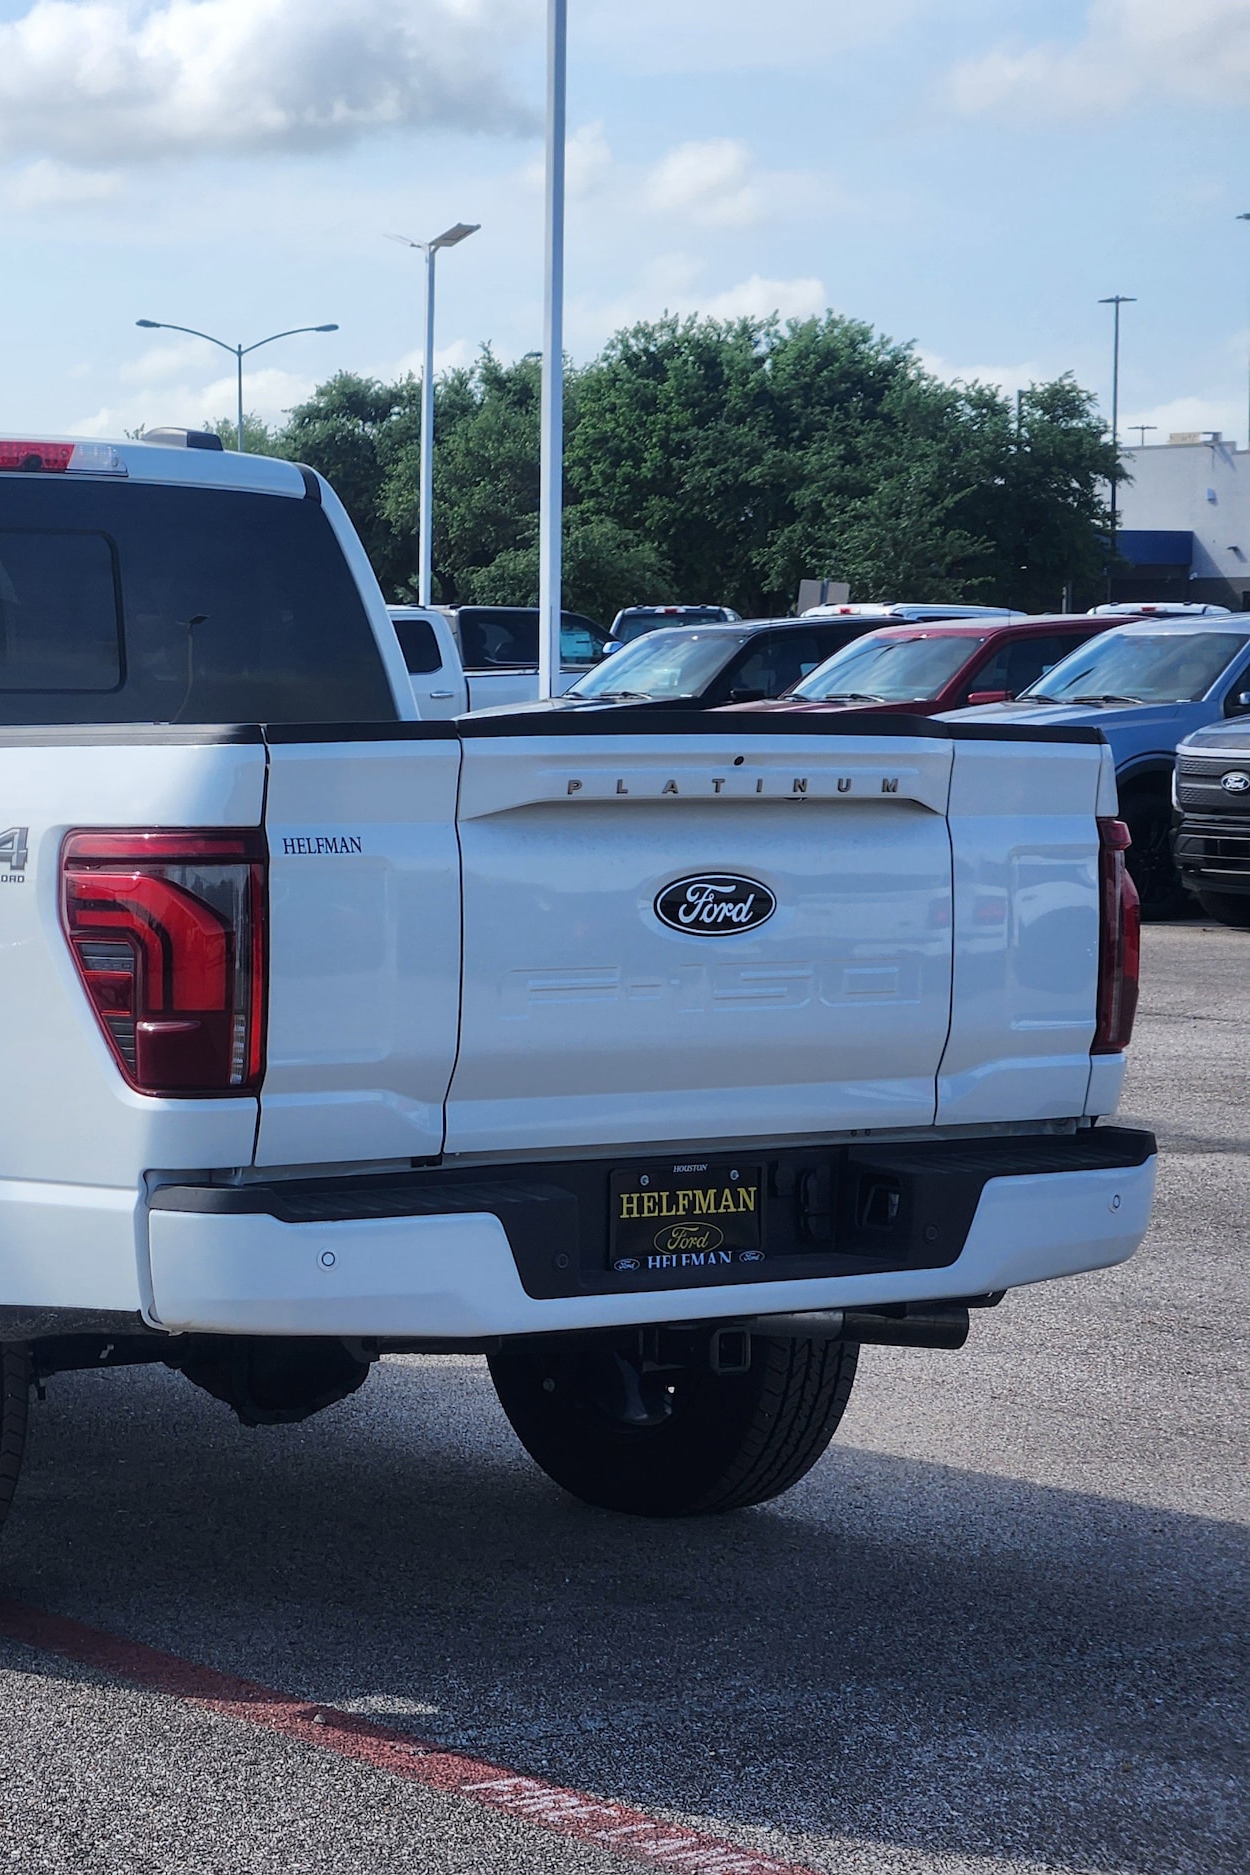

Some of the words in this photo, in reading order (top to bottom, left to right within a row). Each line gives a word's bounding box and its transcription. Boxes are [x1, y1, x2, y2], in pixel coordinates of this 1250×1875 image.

[566, 777, 899, 795] PLATINUM
[281, 836, 363, 855] HELFMAN
[677, 882, 756, 924] Ford
[672, 1163, 708, 1173] HOUSTON
[619, 1186, 758, 1219] HELFMAN
[666, 1226, 711, 1250] Ford
